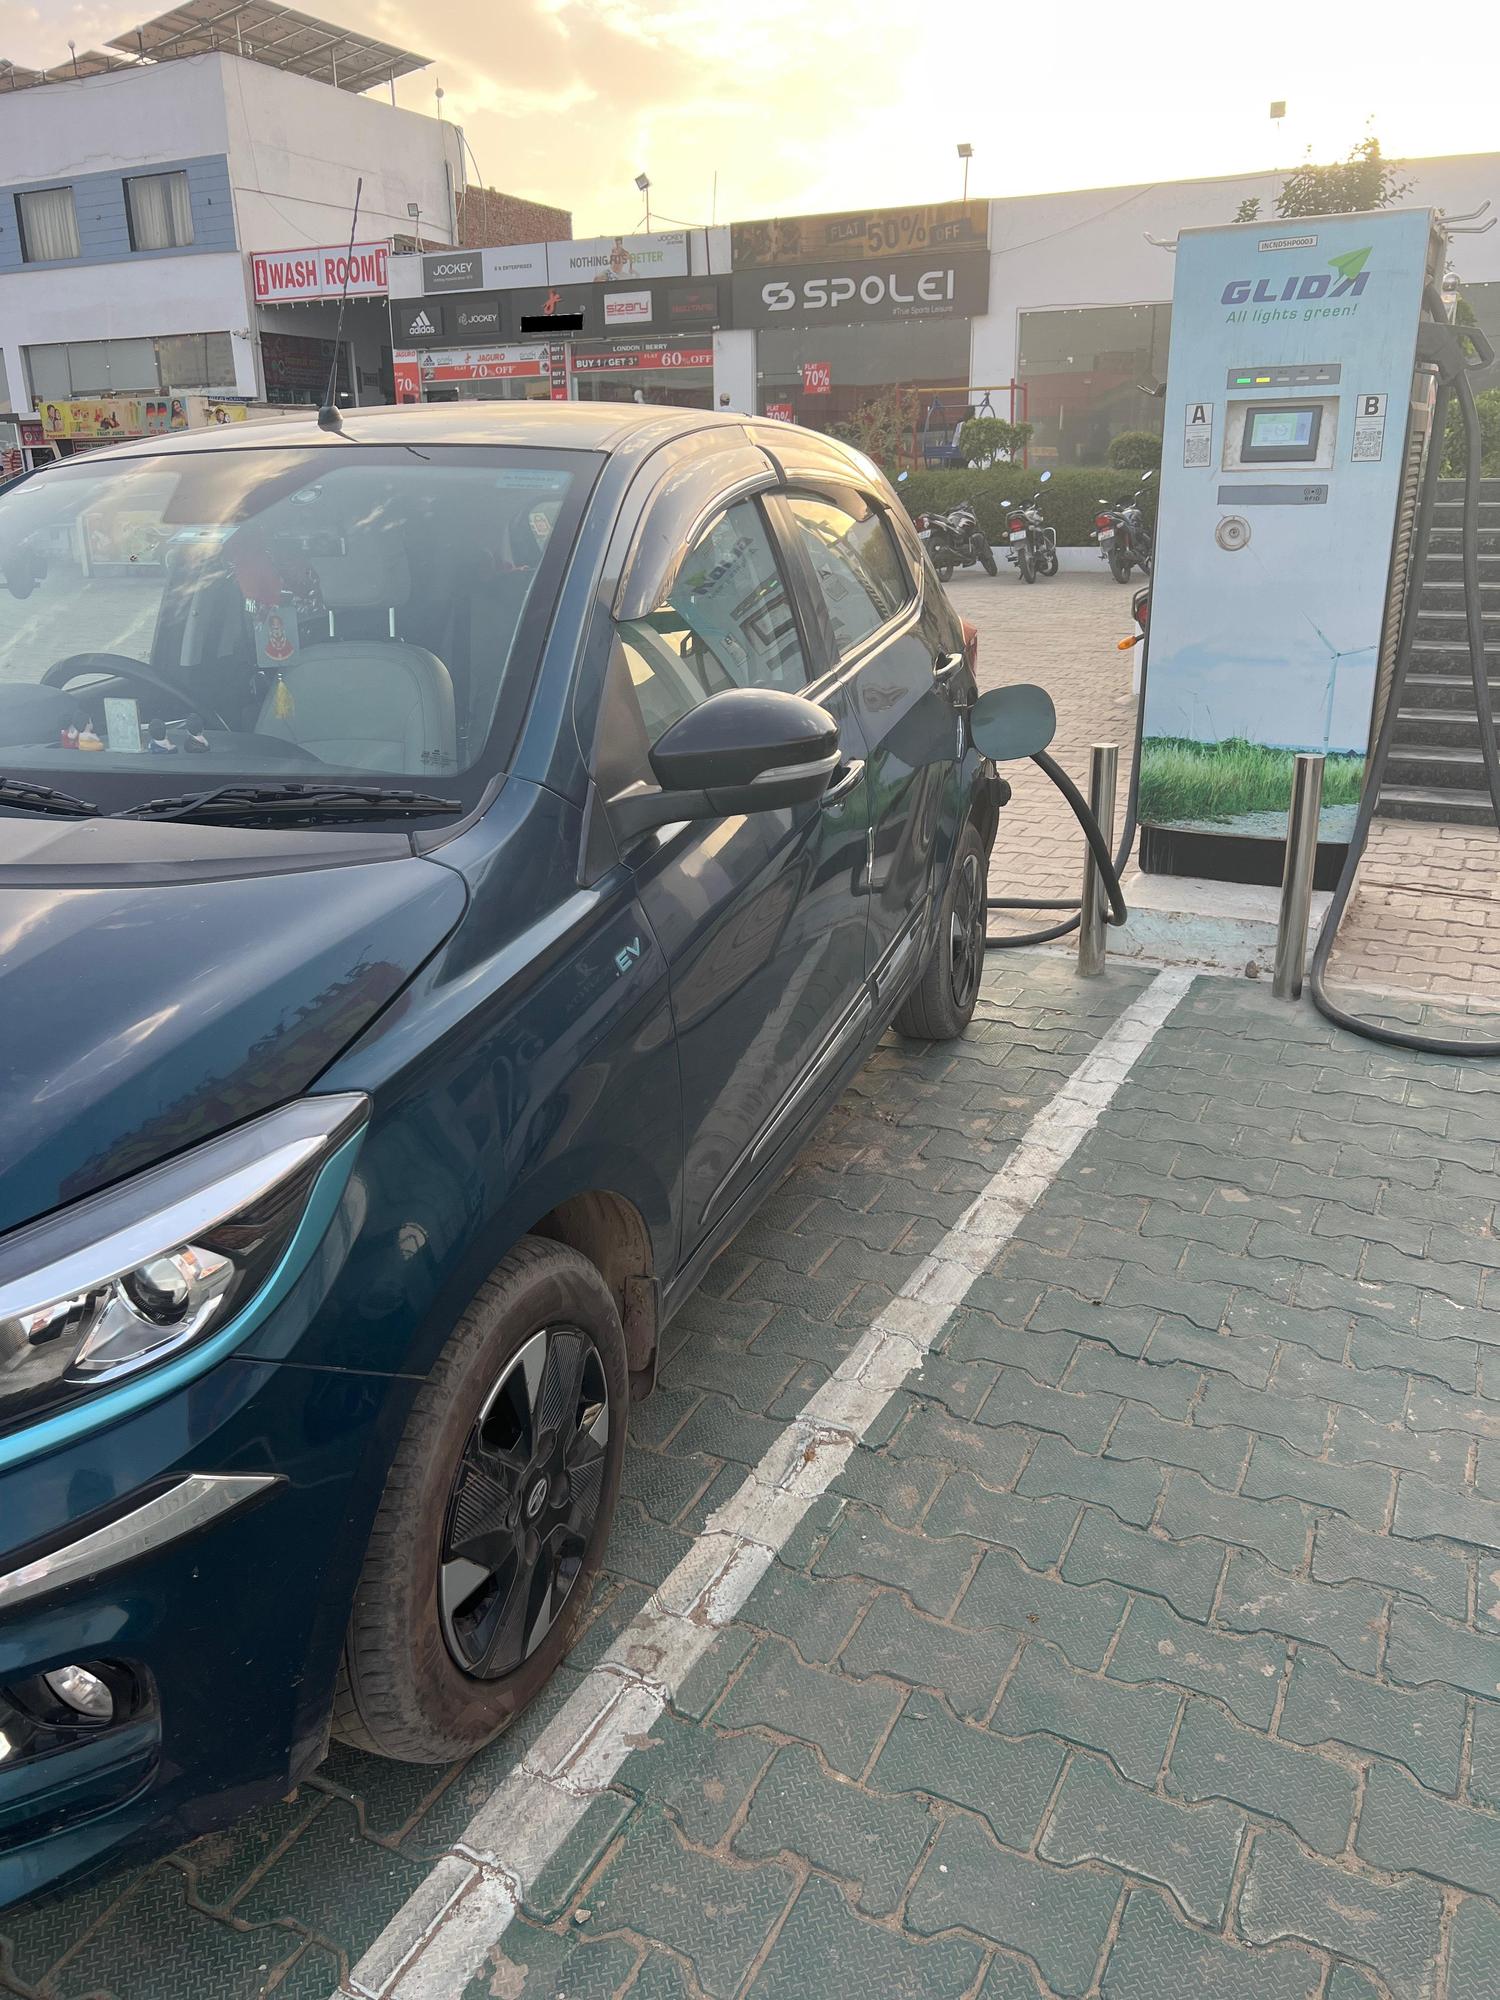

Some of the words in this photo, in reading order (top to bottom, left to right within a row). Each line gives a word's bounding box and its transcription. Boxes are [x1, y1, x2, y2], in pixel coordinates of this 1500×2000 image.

[831, 222, 860, 240] FLAT
[867, 214, 926, 252] 50%
[937, 223, 960, 241] OFF
[269, 259, 318, 289] WASH
[324, 254, 375, 285] ROOM
[433, 262, 472, 276] JOCKEY
[569, 255, 609, 269] NOTHING
[803, 269, 955, 309] SPOLEI
[1220, 271, 1371, 305] GLIDA
[468, 314, 497, 324] JOCKEY
[1225, 310, 1248, 324] All
[1252, 308, 1298, 325] lights
[1303, 303, 1358, 322] green!
[409, 325, 436, 335] adidas
[576, 359, 594, 368] BUY
[608, 358, 626, 366] GET
[690, 354, 712, 364] OFF
[805, 369, 830, 386] 70%
[1192, 405, 1206, 424] A
[1364, 396, 1380, 416] B
[615, 936, 640, 972] EV
